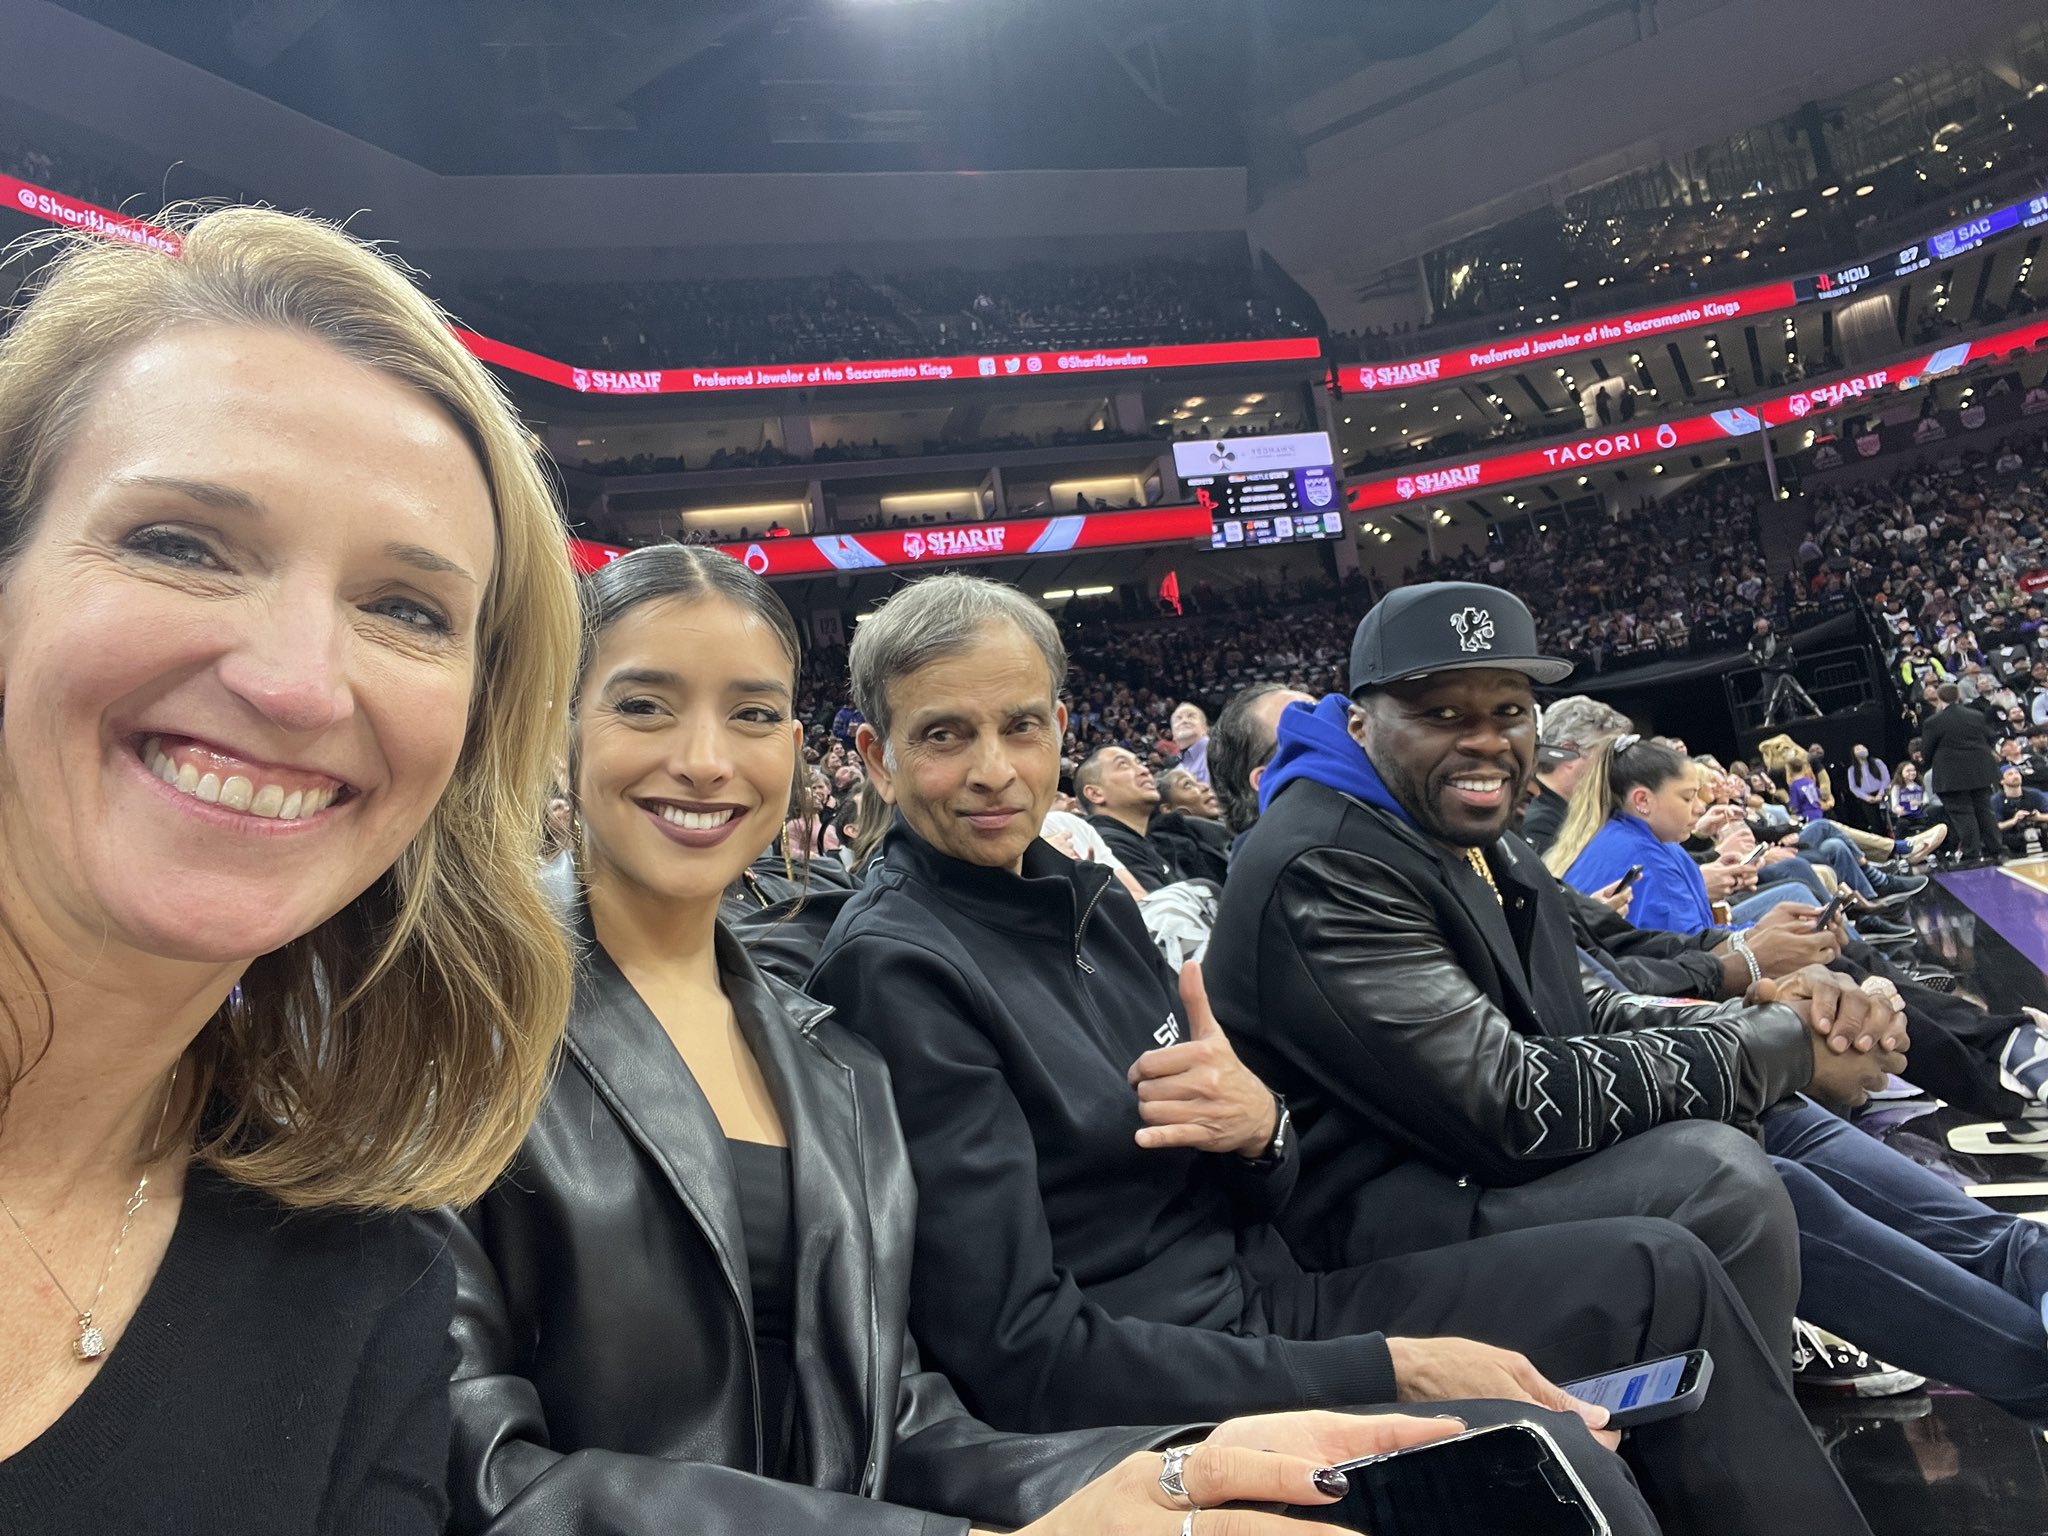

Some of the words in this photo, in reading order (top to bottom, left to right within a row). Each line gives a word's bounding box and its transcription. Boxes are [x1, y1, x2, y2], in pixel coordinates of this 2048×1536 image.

[1957, 218, 1991, 241] SAC
[1837, 265, 1870, 285] HOU
[1469, 342, 1530, 367] Preferred
[1532, 333, 1581, 354] Jeweler
[1583, 326, 1597, 343] of
[1599, 324, 1621, 340] the
[1623, 308, 1701, 335] Sacramento
[1703, 300, 1741, 318] Kings
[1057, 352, 1148, 369] @SharifJewelers
[1376, 358, 1440, 383] SHARIF
[591, 371, 662, 389] SHARIF
[692, 370, 753, 388] Preferred
[756, 368, 804, 385] Jeweler
[806, 366, 821, 382] of
[822, 367, 843, 381] the
[845, 365, 917, 380] Sacramento
[919, 362, 953, 379] Kings
[1810, 371, 1888, 402] SHARIF
[1543, 432, 1640, 466] TACORI
[1415, 463, 1480, 491] SHARIF
[926, 526, 1006, 551] SHARIF
